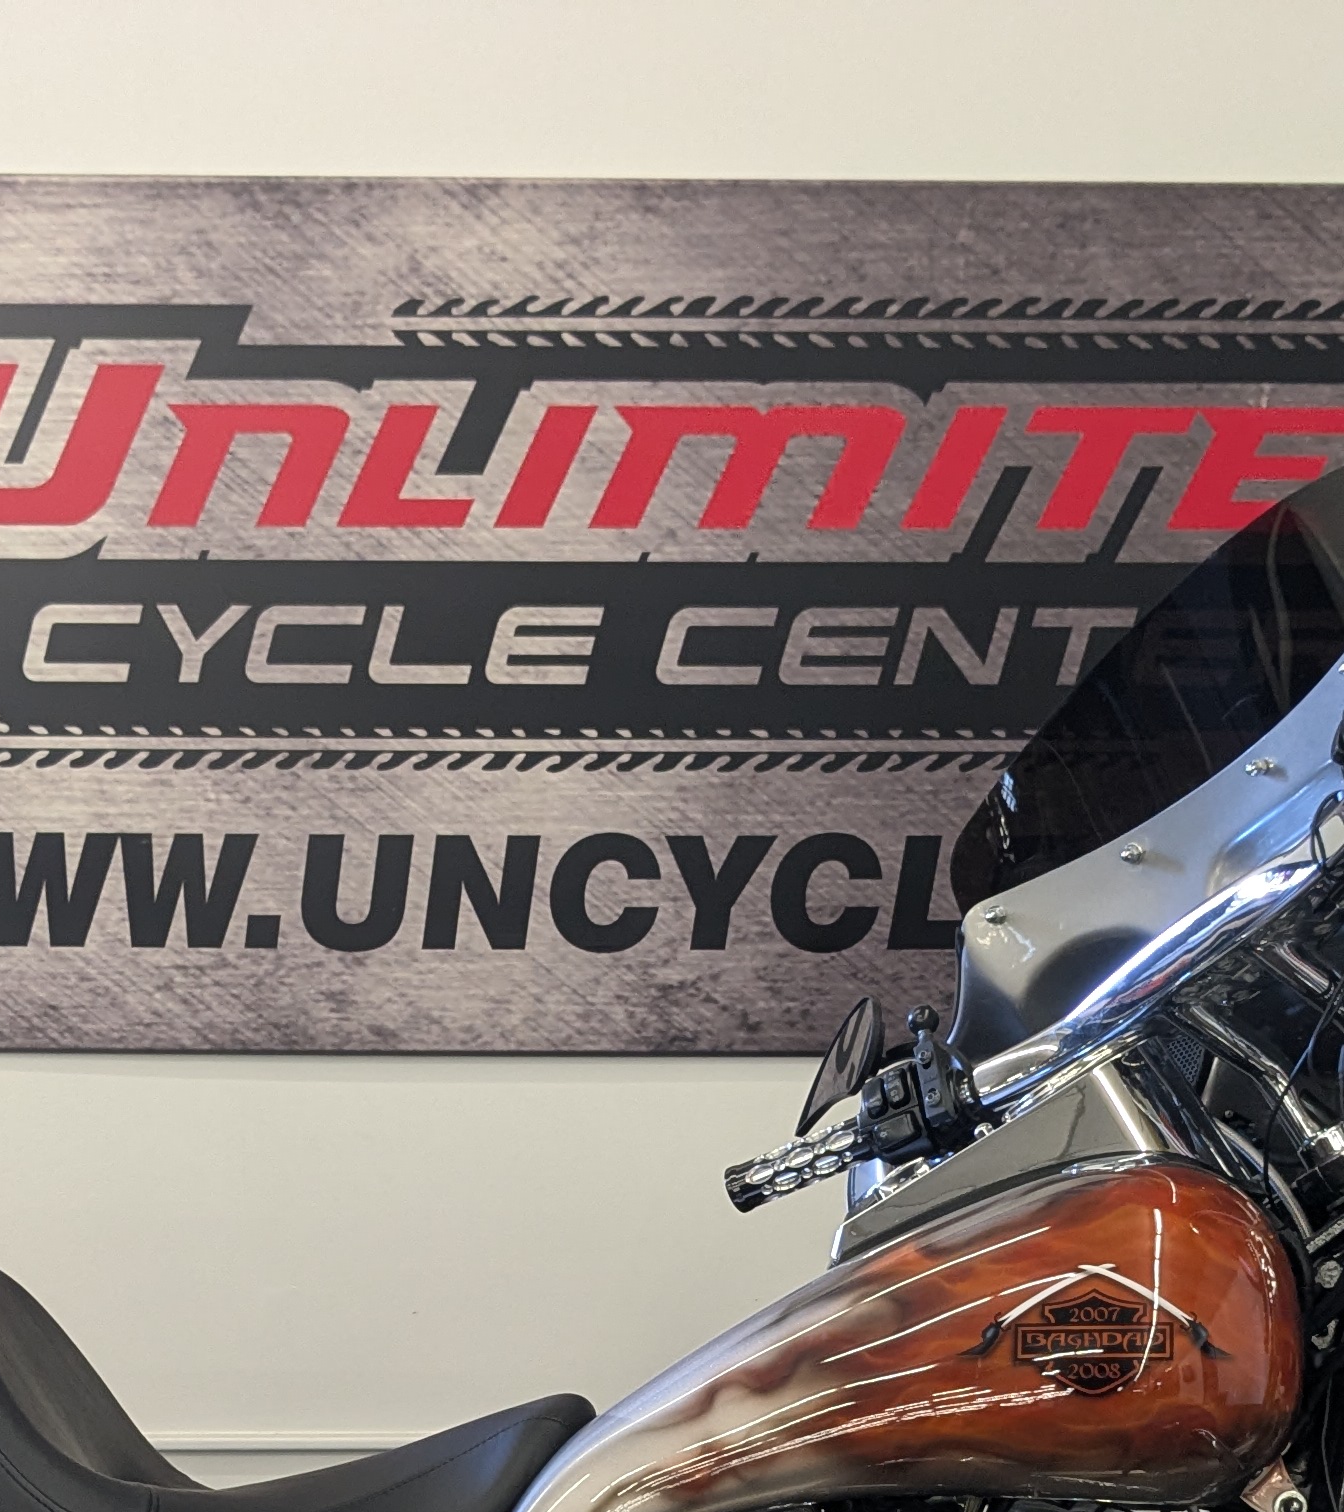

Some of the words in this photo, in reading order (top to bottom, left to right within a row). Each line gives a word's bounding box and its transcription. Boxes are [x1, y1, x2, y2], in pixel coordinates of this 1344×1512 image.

[21, 600, 606, 686] CYCLE
[655, 604, 1240, 690] CENT
[1069, 1306, 1120, 1323] 2007
[1067, 1362, 1122, 1380] 2008
